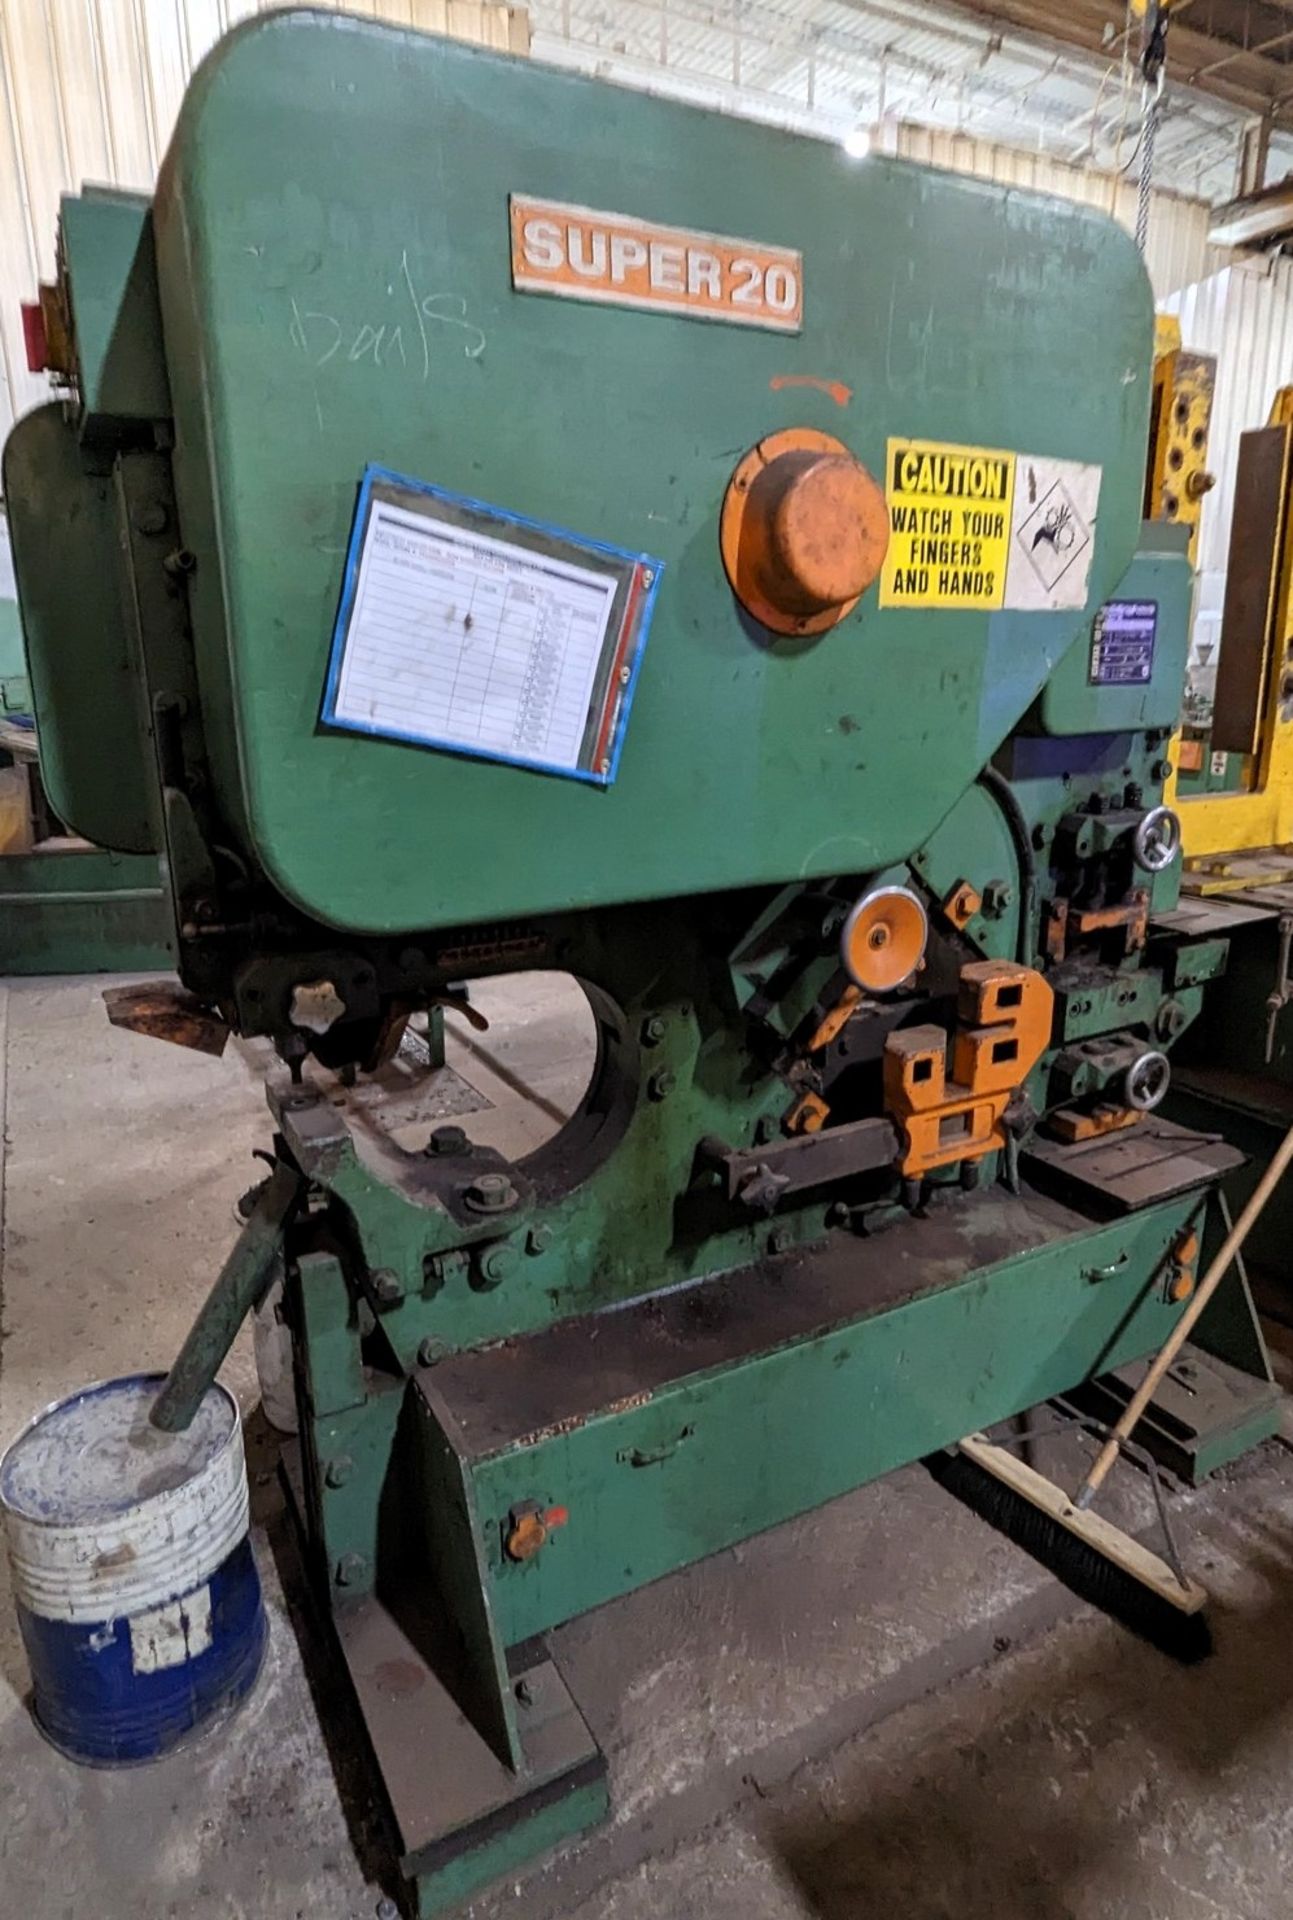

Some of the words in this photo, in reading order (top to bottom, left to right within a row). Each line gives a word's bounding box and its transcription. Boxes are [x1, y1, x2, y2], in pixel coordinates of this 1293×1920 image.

[900, 452, 1003, 499] CAUTION
[891, 506, 953, 535] WATCH
[962, 508, 1004, 540] YOUR
[910, 538, 982, 568] FINGERS
[893, 567, 929, 595] AND
[938, 570, 995, 597] HANDS
